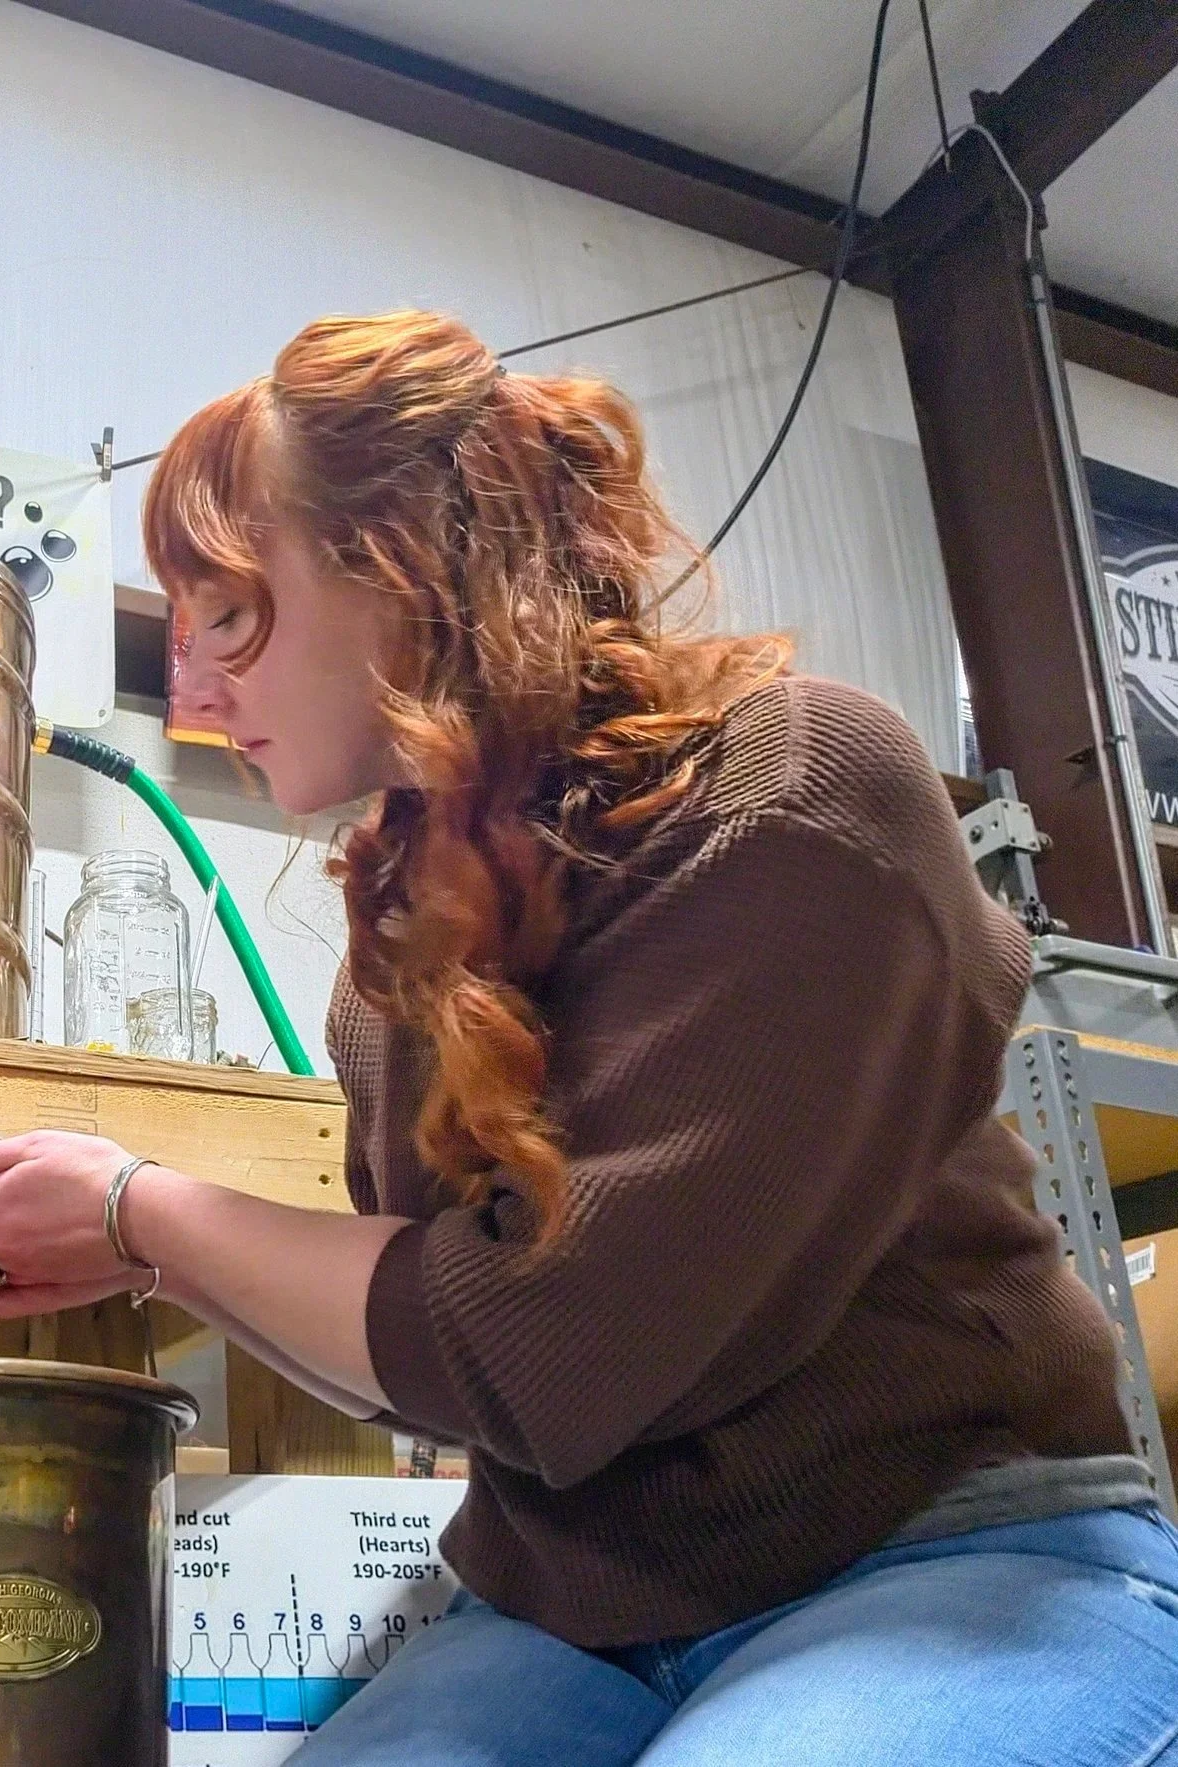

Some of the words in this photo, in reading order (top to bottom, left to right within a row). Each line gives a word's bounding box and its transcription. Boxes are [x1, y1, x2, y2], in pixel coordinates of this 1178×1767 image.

[203, 1512, 230, 1526] cut
[350, 1511, 396, 1527] Third
[402, 1515, 430, 1528] cut
[359, 1535, 430, 1557] (Hearts)
[10, 1584, 57, 1602] GEORGIA
[194, 1612, 206, 1630] 5
[233, 1612, 245, 1630] 6
[274, 1613, 286, 1631] 7
[310, 1613, 323, 1631] 8
[349, 1614, 361, 1631] 9
[382, 1614, 406, 1633] 10
